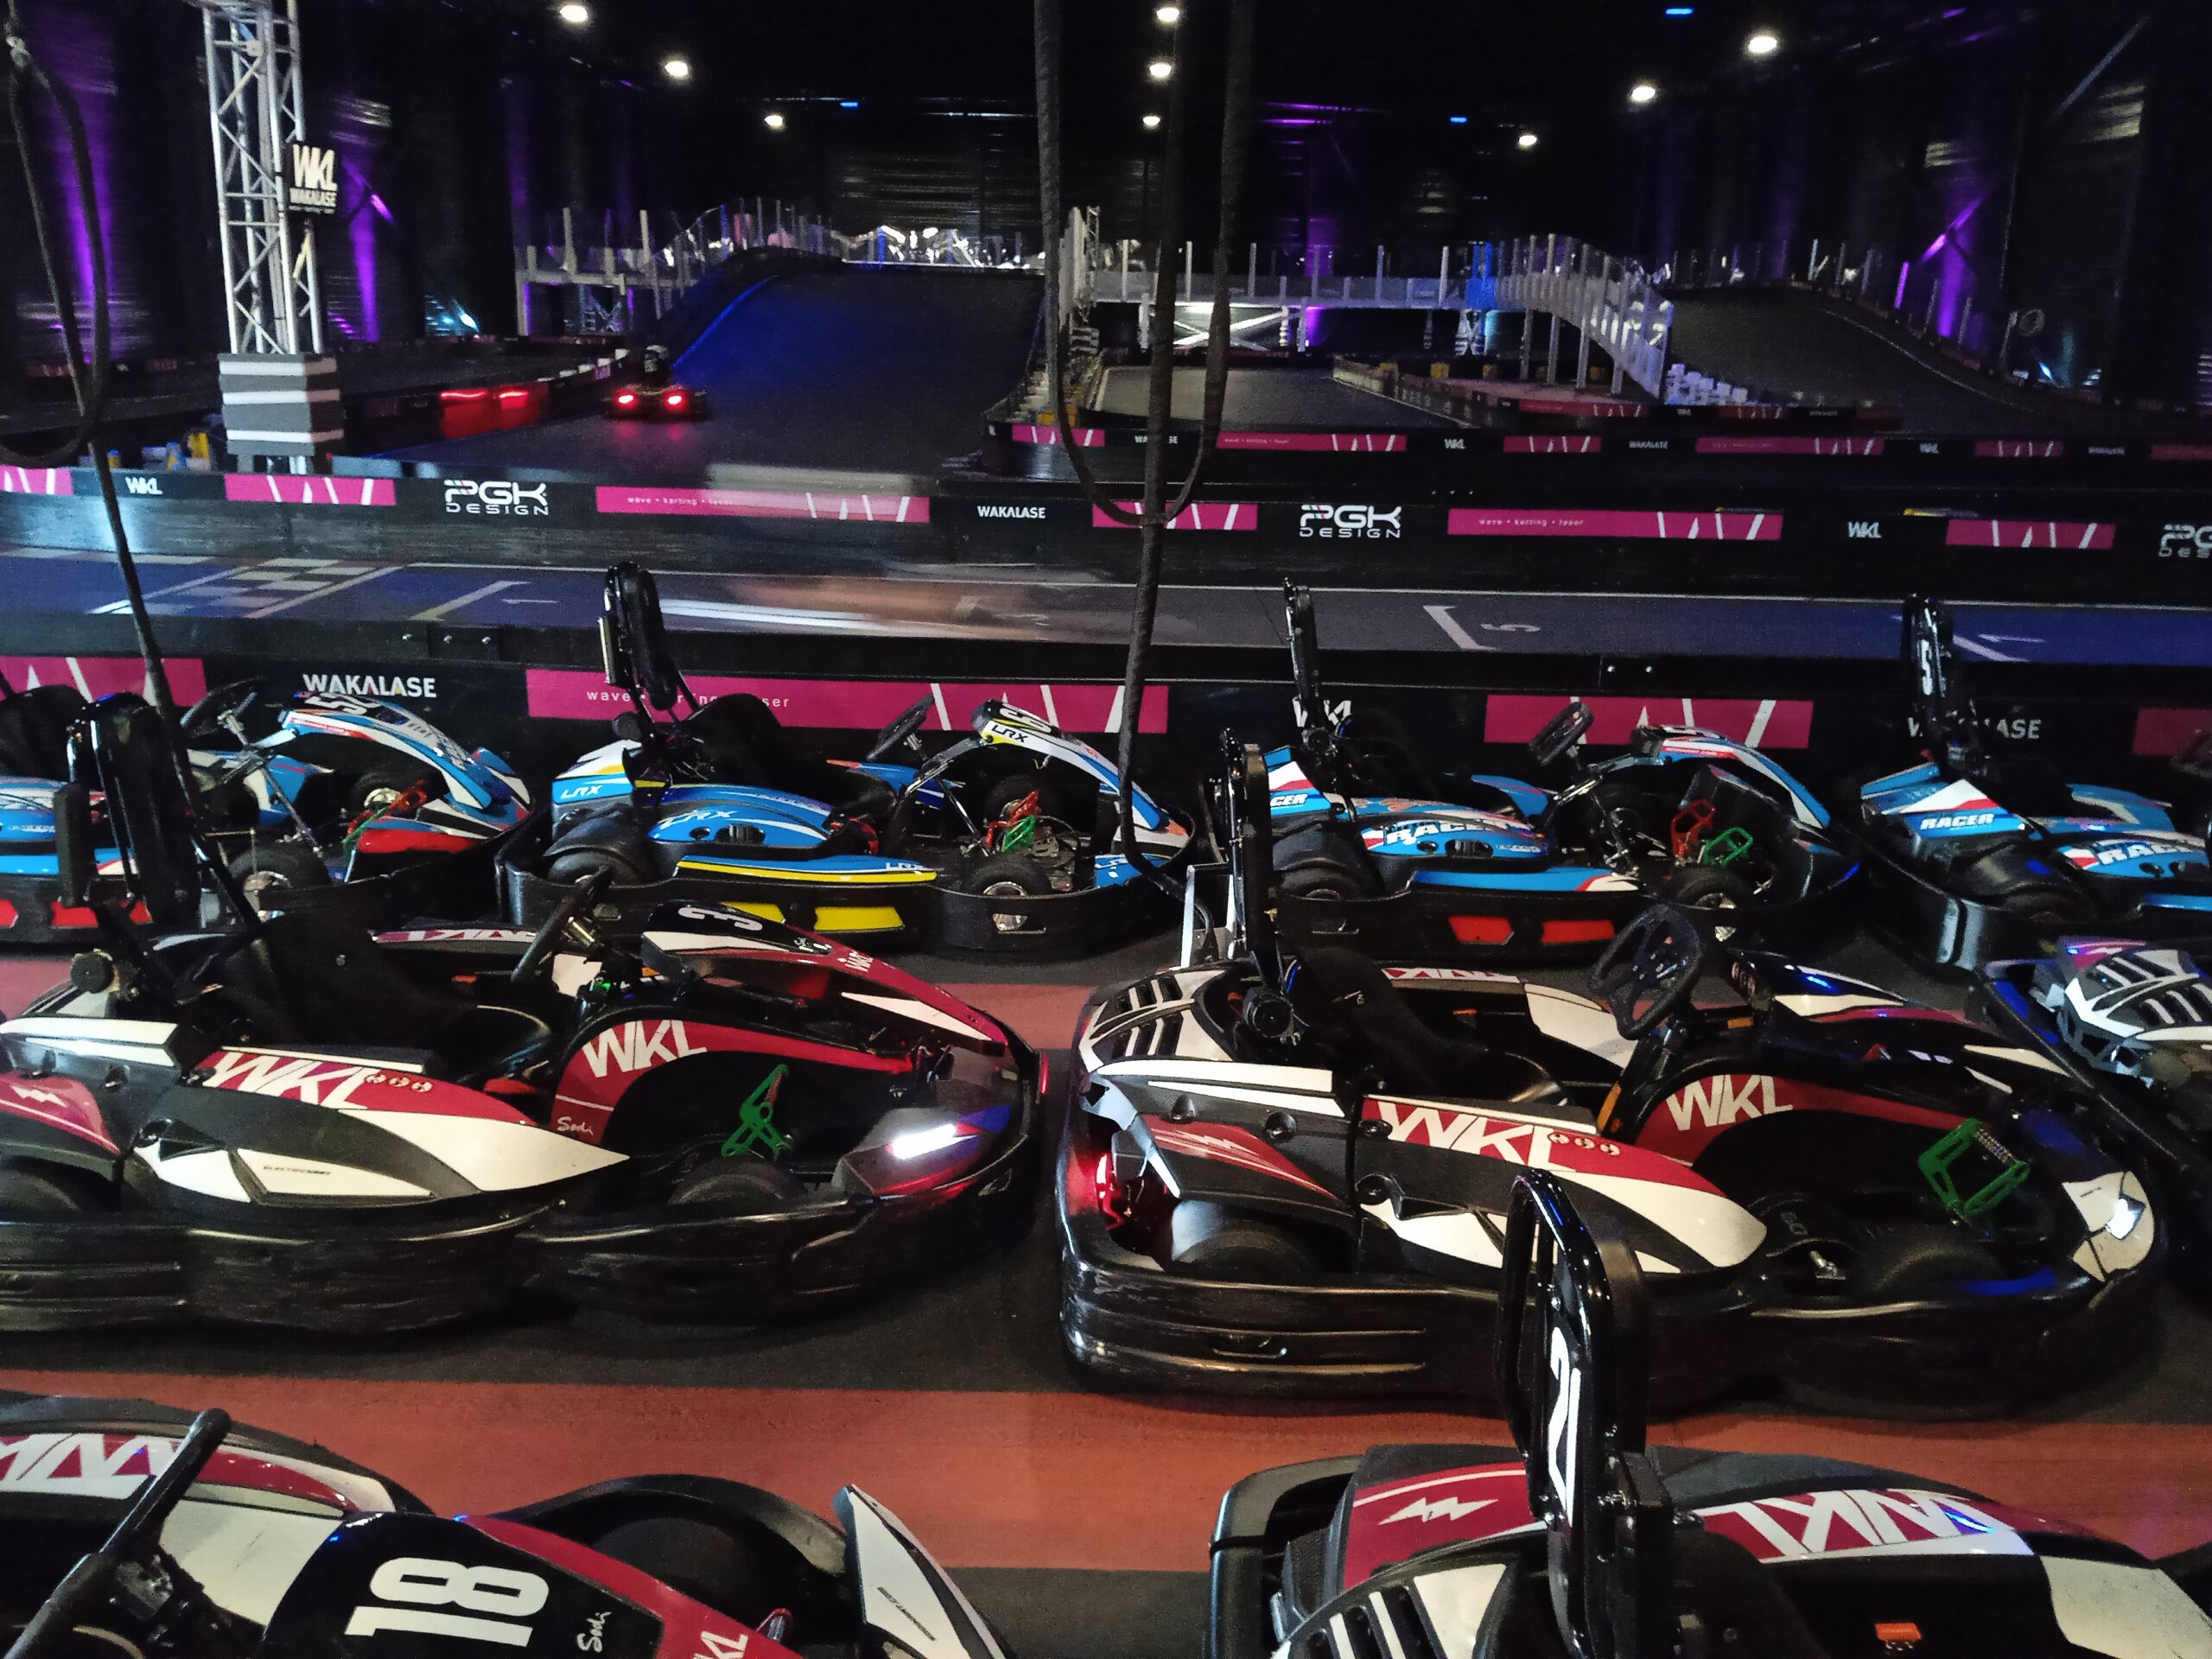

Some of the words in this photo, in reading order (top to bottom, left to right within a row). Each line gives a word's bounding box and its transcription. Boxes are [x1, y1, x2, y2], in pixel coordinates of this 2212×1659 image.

[292, 143, 338, 190] WKL
[125, 476, 163, 495] WKL
[443, 480, 548, 506] PGK
[445, 503, 549, 516] DESIGN
[976, 505, 1046, 519] WAKALASE
[1300, 505, 1401, 530] PGK
[1300, 527, 1401, 538] DESIGN
[1847, 521, 1882, 538] WKL
[302, 673, 437, 698] WAKALASE
[588, 690, 631, 702] wave
[762, 697, 790, 707] ser
[991, 724, 1029, 743] LRX
[560, 784, 603, 798] LRX
[1269, 793, 1308, 807] CER
[1919, 812, 1996, 831] RACER
[582, 1019, 708, 1077] WKL
[202, 1050, 369, 1110] WKL
[1664, 1074, 1794, 1132] WKL
[1376, 1099, 1577, 1173] WKL
[345, 1556, 550, 1648] 18
